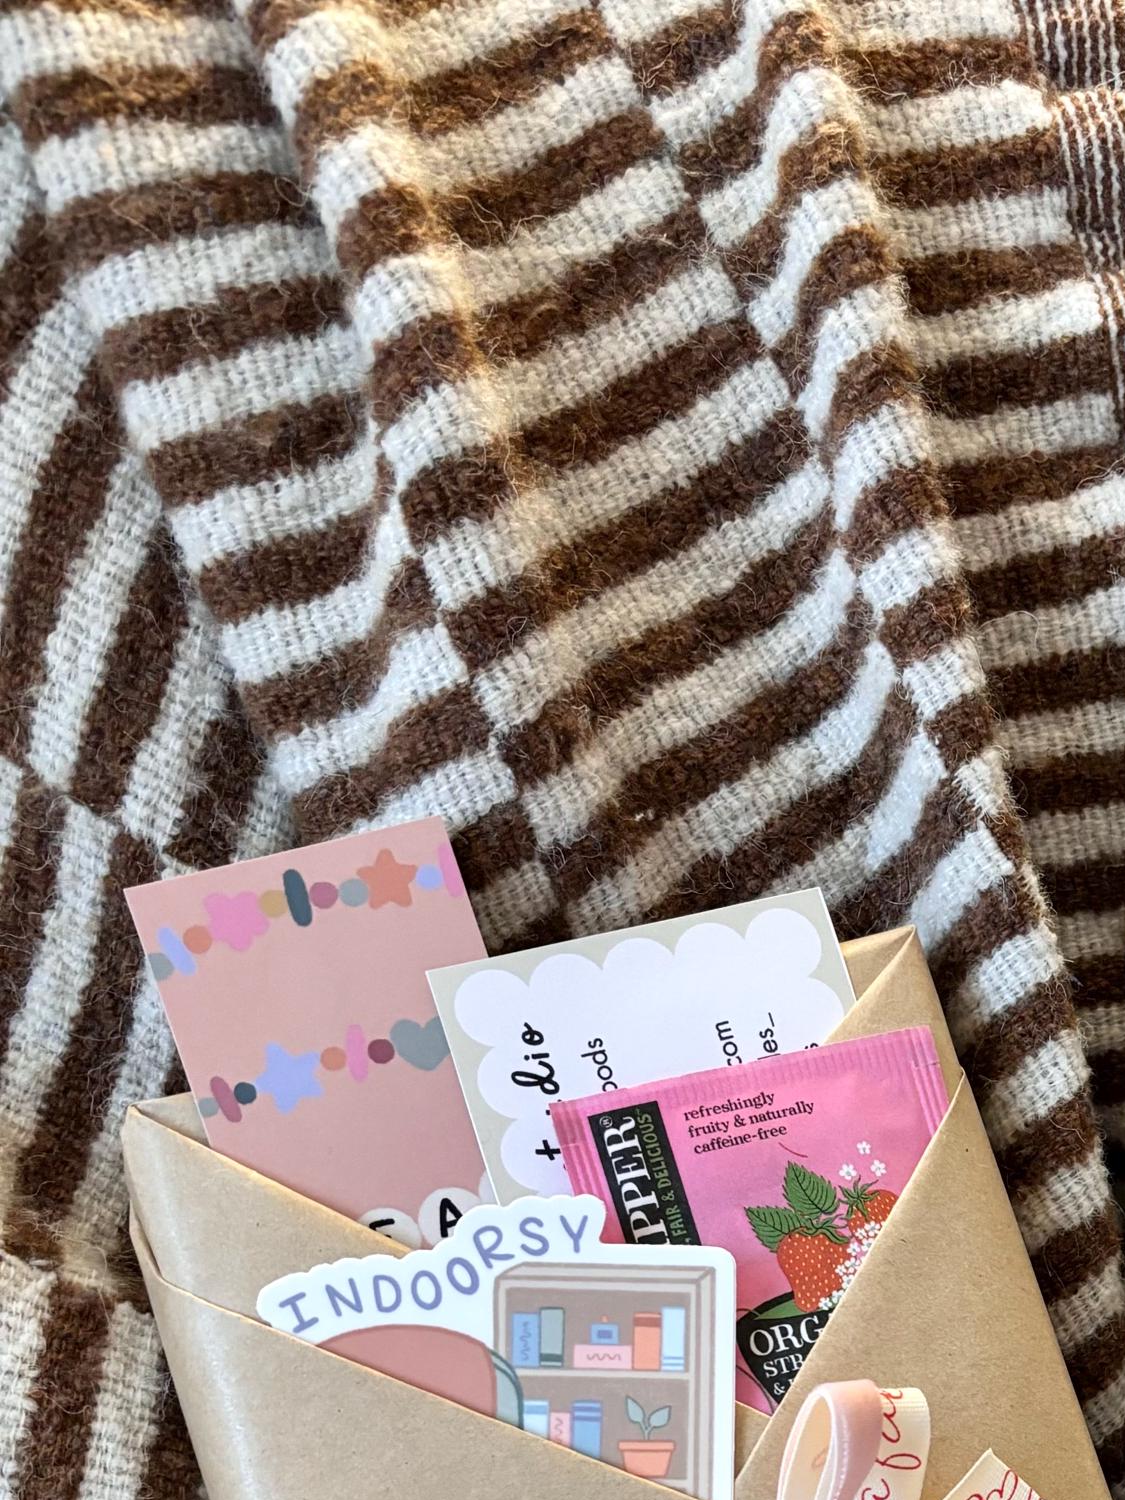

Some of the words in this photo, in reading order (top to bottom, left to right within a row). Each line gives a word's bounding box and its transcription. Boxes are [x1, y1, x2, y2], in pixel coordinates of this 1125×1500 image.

[683, 1091, 775, 1122] refreshingly
[687, 1120, 729, 1139] fruity
[733, 1114, 747, 1128] &
[748, 1100, 815, 1125] naturally
[636, 1112, 672, 1190] DELICIOUS
[693, 1125, 788, 1155] caffeine-free
[661, 1190, 676, 1201] &
[665, 1204, 687, 1238] FAIR
[278, 1214, 589, 1334] INDOORSY
